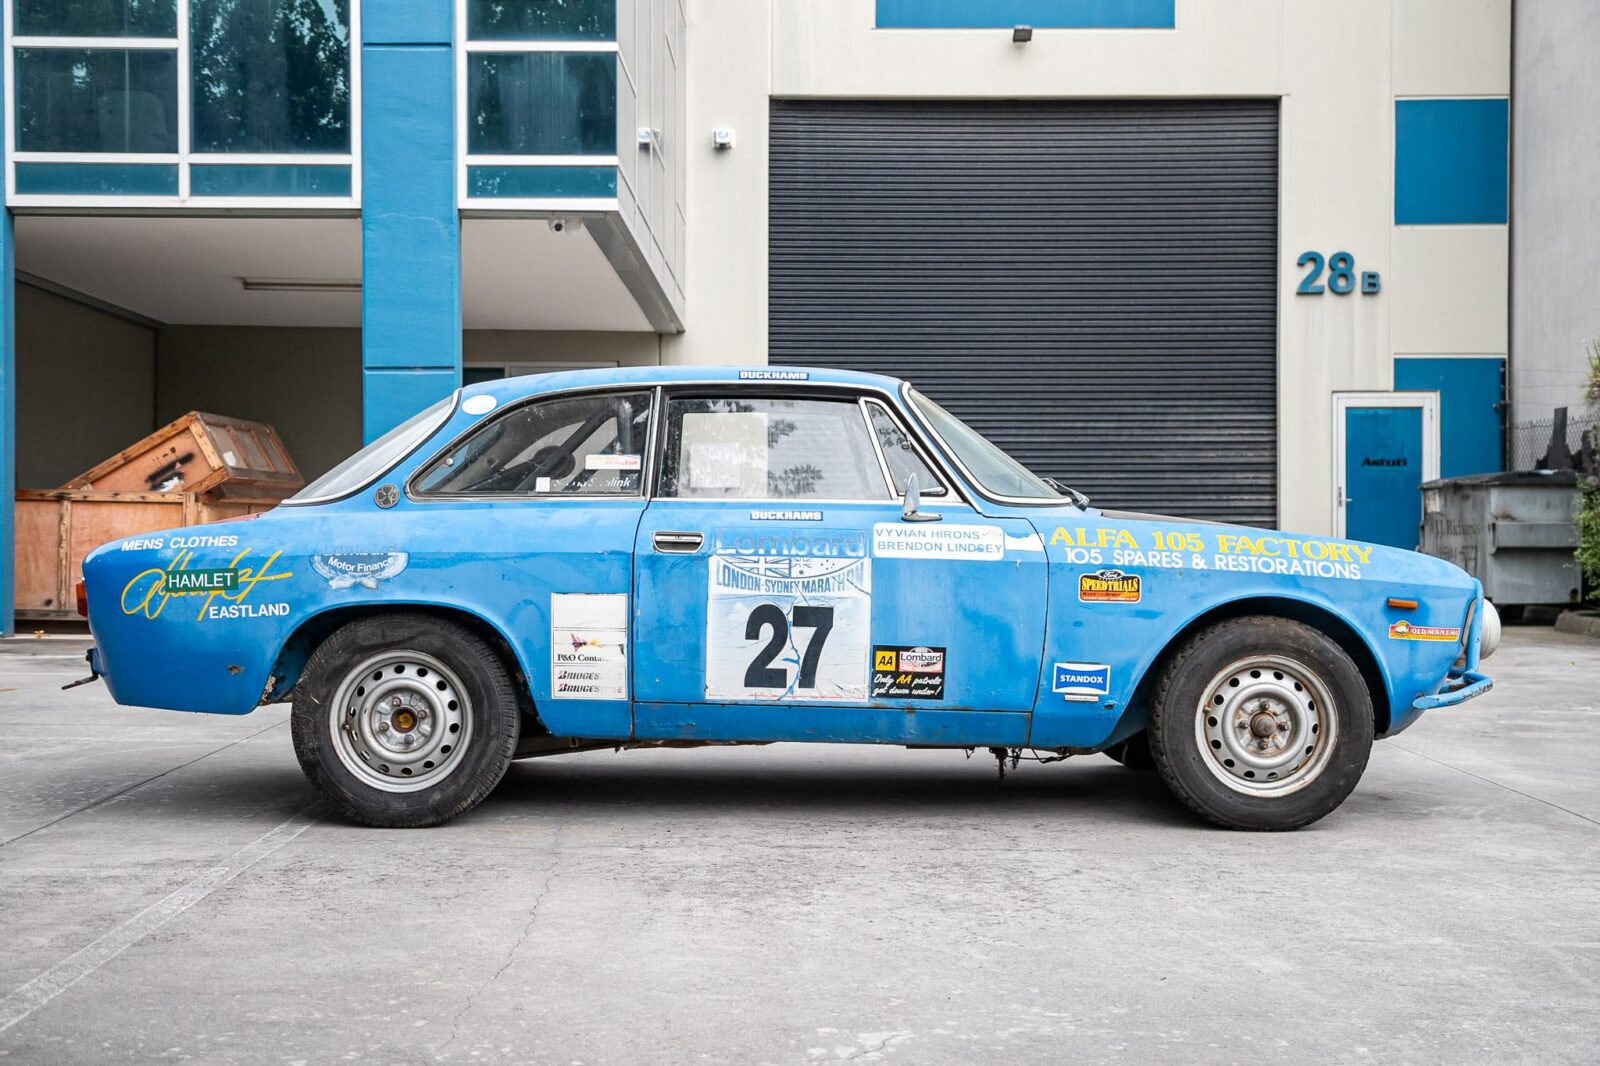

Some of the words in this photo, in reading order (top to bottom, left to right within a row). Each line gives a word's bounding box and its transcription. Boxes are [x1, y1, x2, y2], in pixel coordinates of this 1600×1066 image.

[740, 371, 807, 379] DUCKHAMS
[751, 511, 822, 520] DUCKHAMS
[875, 528, 926, 538] VYVIAN
[931, 531, 980, 540] HIRONS
[121, 538, 164, 551] MENS
[170, 535, 238, 548] CLOTHES
[878, 541, 942, 551] BRENDON
[947, 543, 1002, 553] LINDSEY
[1049, 526, 1139, 549] ALFA
[1152, 531, 1204, 552] 105
[1216, 534, 1373, 564] FACTORY
[328, 556, 355, 572] Motor
[357, 556, 394, 572] Finance
[1065, 547, 1103, 565] 105
[1113, 549, 1183, 568] SPARES
[1191, 553, 1208, 570] &
[1214, 554, 1361, 580] RESTORATIONS
[168, 572, 234, 588] HAMLET
[1082, 577, 1107, 591] SPEED
[1108, 578, 1138, 591] TRIALS
[209, 603, 290, 619] EASTLAND
[744, 604, 834, 689] 27
[878, 656, 893, 666] AA
[901, 653, 941, 662] Lombard
[874, 674, 894, 688] Only
[896, 675, 912, 684] AA
[912, 676, 941, 687] patrols
[1060, 675, 1103, 684] STANDOX
[872, 687, 888, 697] get
[889, 686, 910, 694] down
